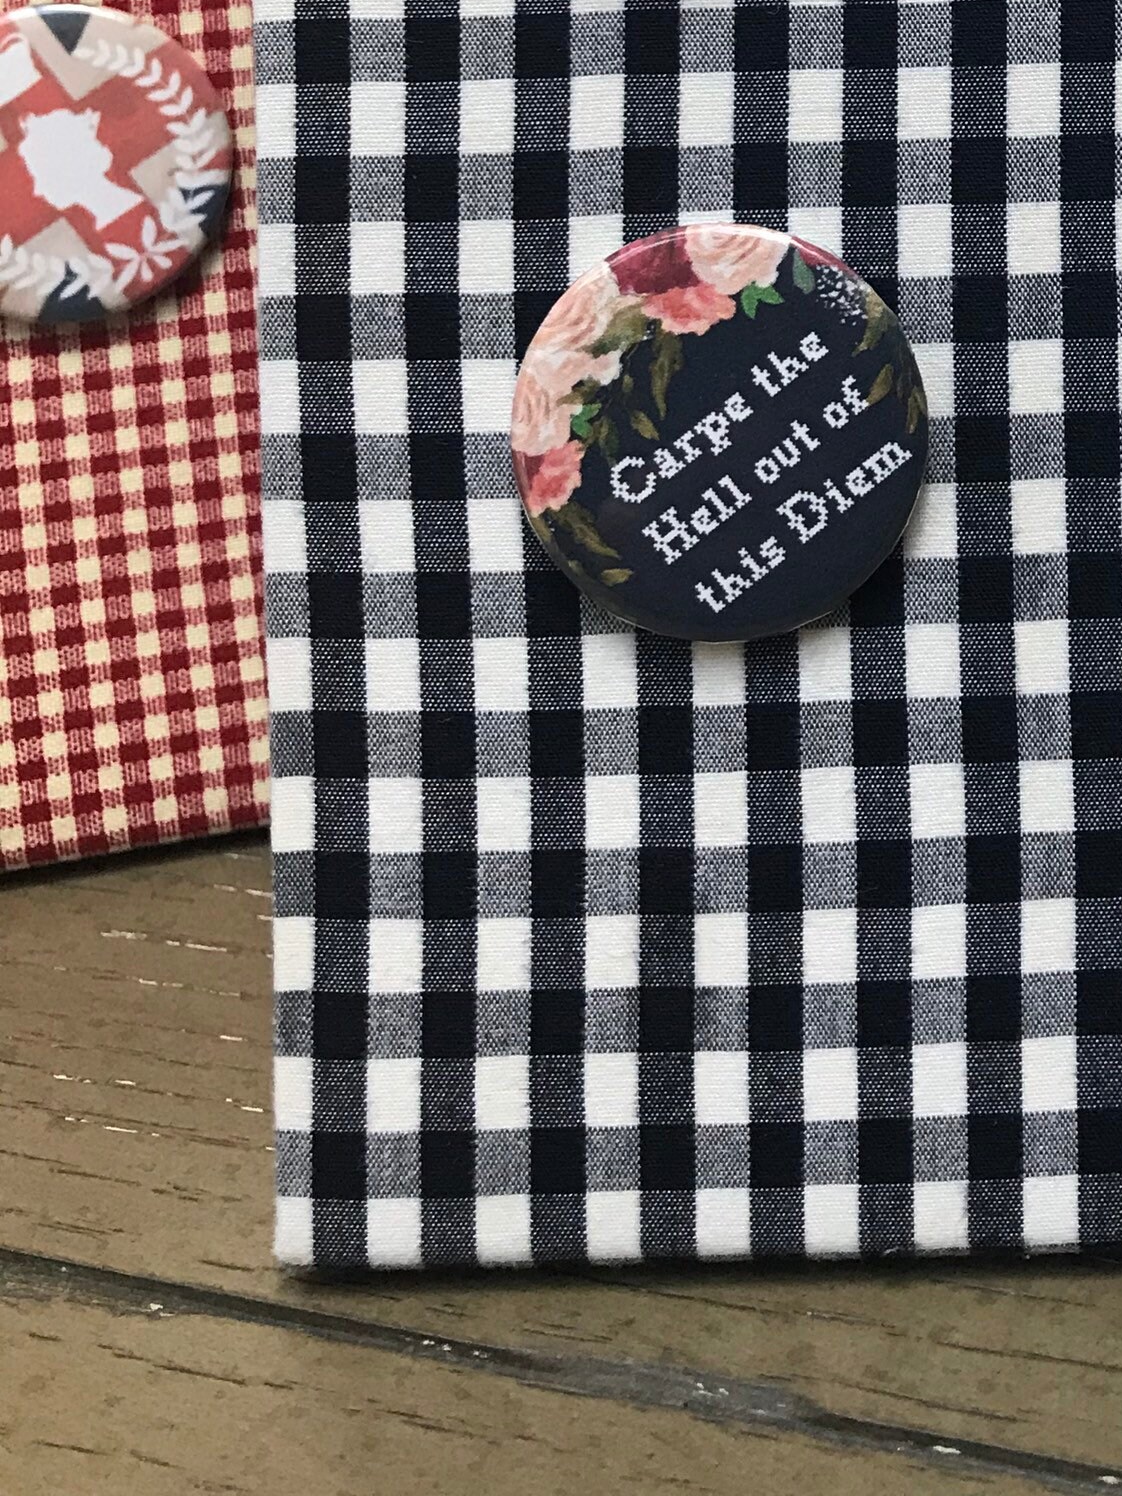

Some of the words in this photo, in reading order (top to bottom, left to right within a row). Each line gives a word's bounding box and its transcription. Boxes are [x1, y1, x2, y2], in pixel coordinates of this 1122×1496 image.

[609, 391, 754, 504] Carpe
[750, 330, 830, 398] the
[641, 474, 753, 566] Hell
[753, 418, 821, 485] out
[822, 374, 870, 430] of
[694, 535, 787, 614] this
[776, 440, 913, 544] Diem
